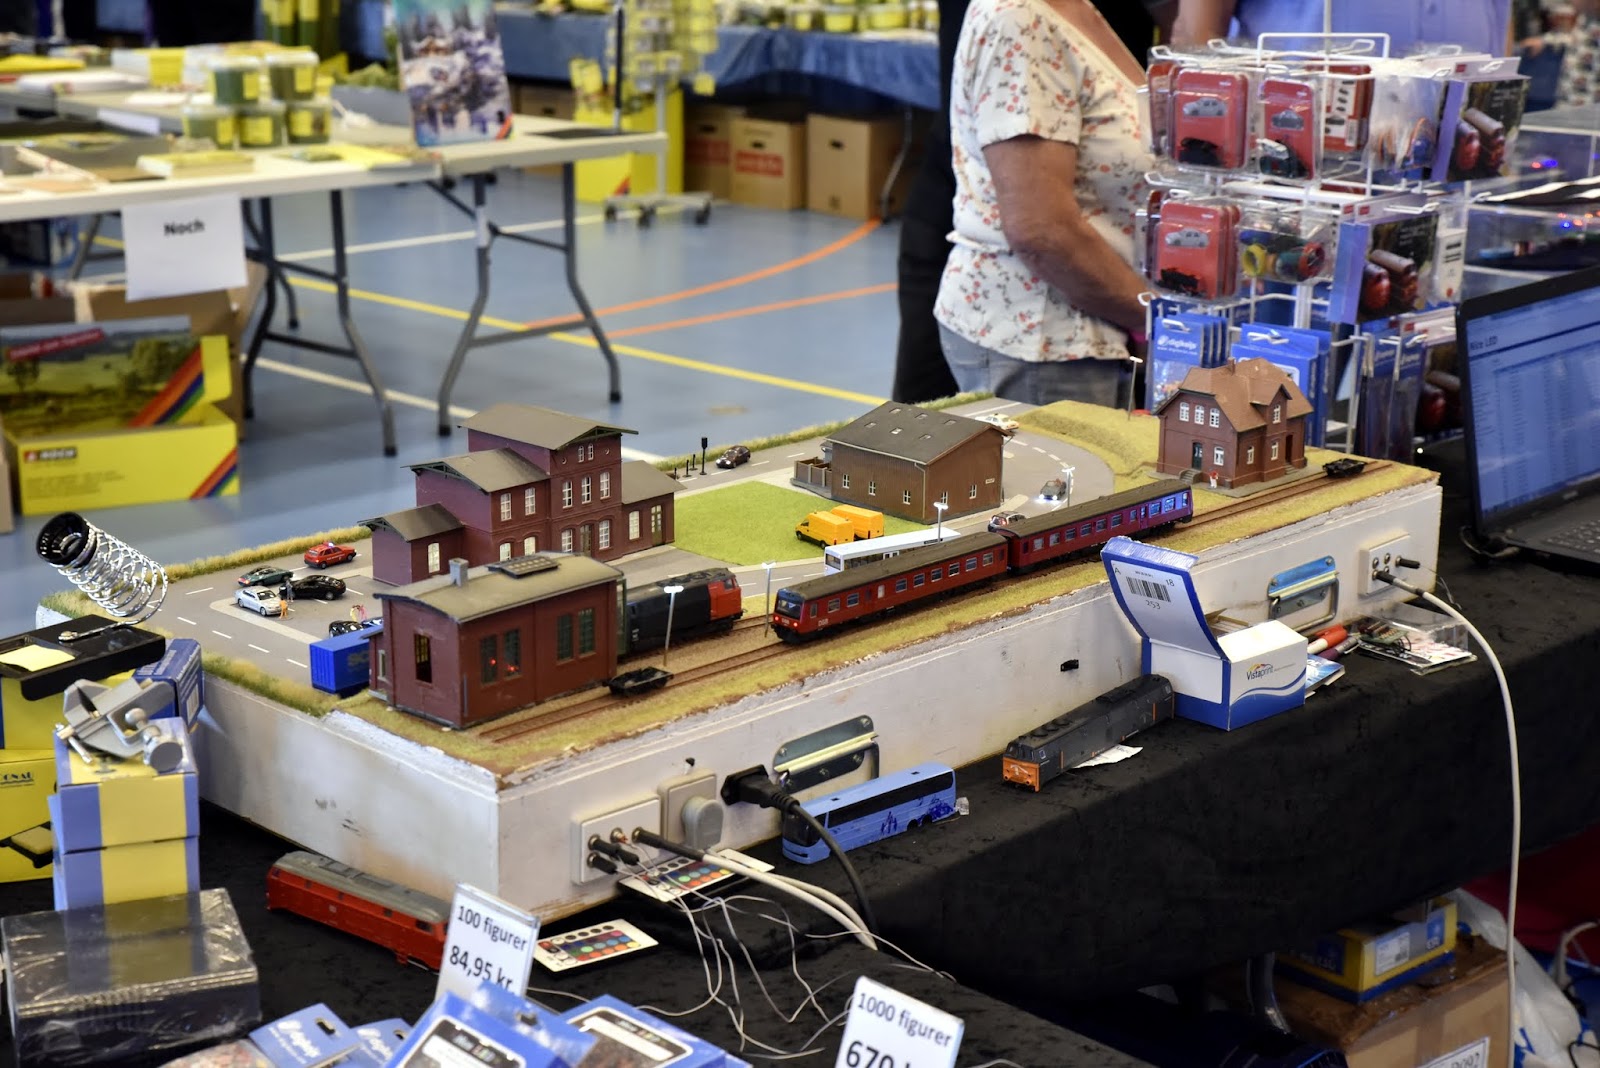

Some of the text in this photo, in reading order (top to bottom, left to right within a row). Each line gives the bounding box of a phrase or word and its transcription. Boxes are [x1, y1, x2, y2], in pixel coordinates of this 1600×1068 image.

[164, 219, 205, 236] Noch
[1113, 567, 1122, 575] A
[1165, 578, 1175, 587] 18
[1246, 667, 1274, 681] Vistaprint
[458, 906, 527, 951] 100 figurer
[449, 945, 492, 980] 84,95
[858, 993, 952, 1047] 1000 figurer
